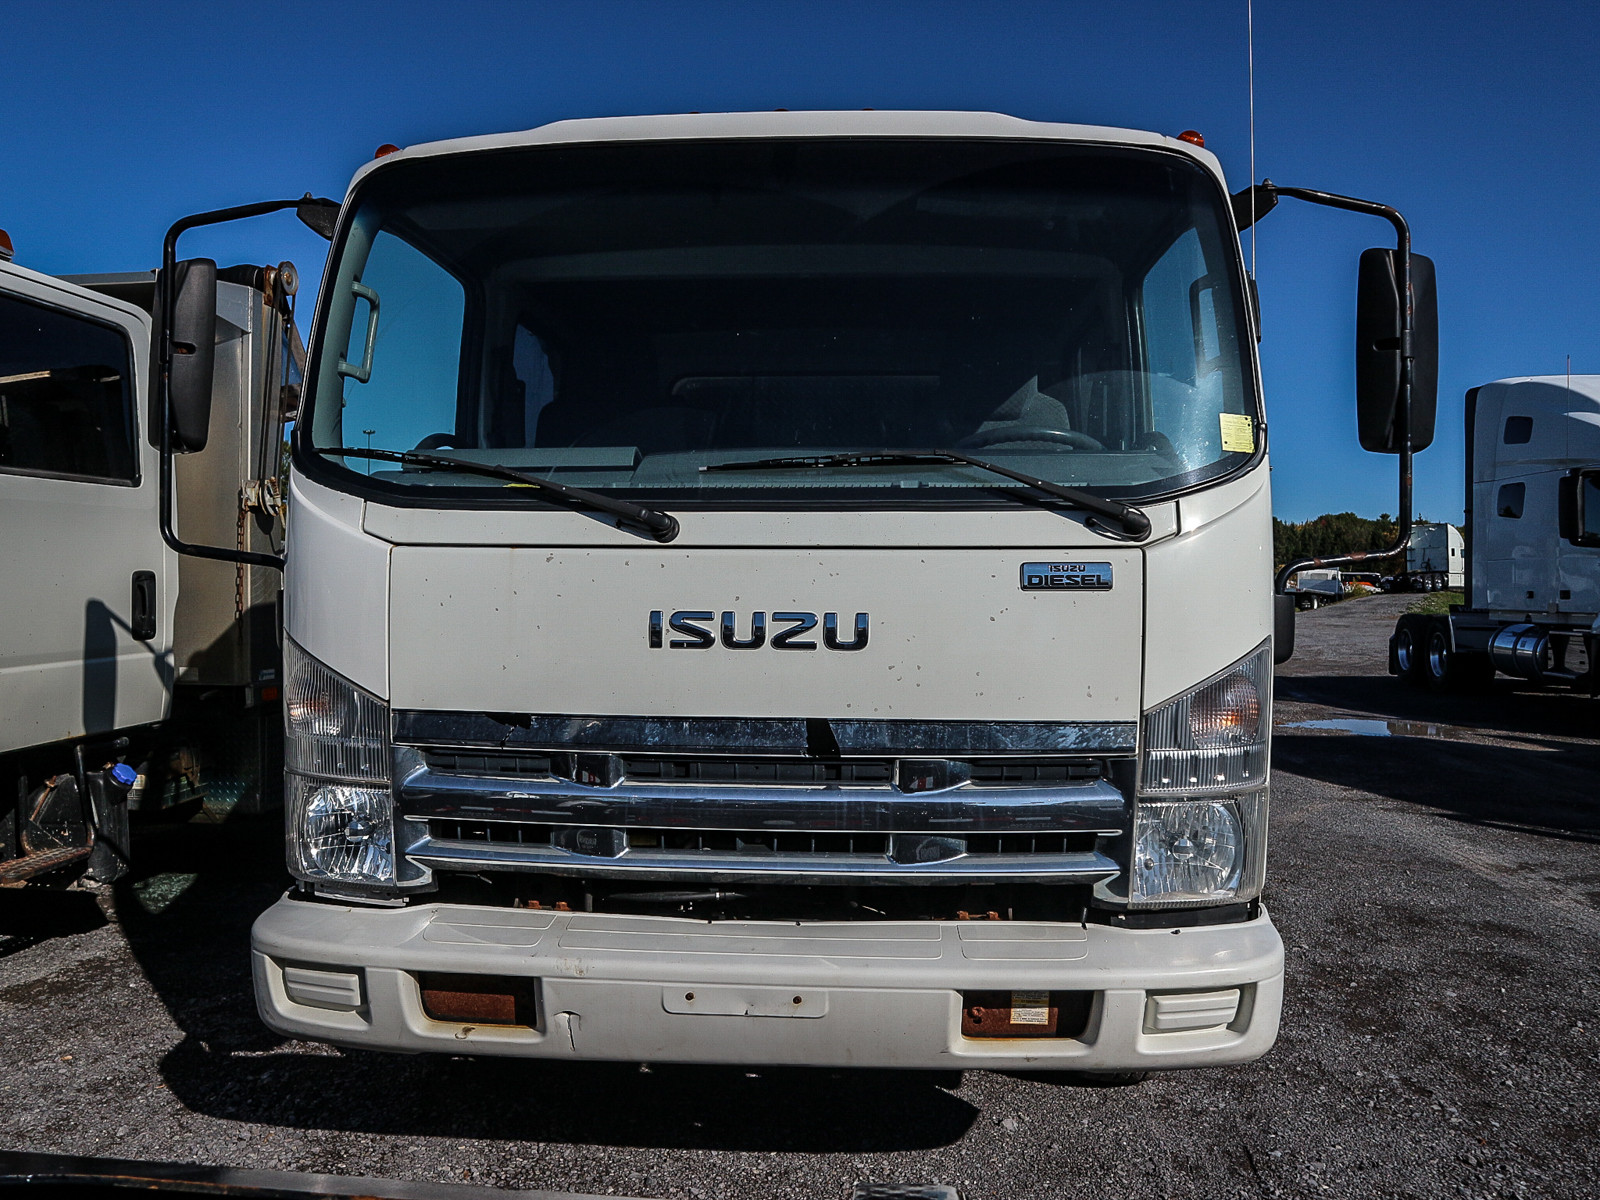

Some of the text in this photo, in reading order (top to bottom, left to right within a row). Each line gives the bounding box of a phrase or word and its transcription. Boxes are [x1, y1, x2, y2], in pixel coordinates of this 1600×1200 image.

[1049, 565, 1086, 573] ISUZU
[1027, 574, 1109, 587] DIESEL
[649, 610, 870, 651] ISUZU
